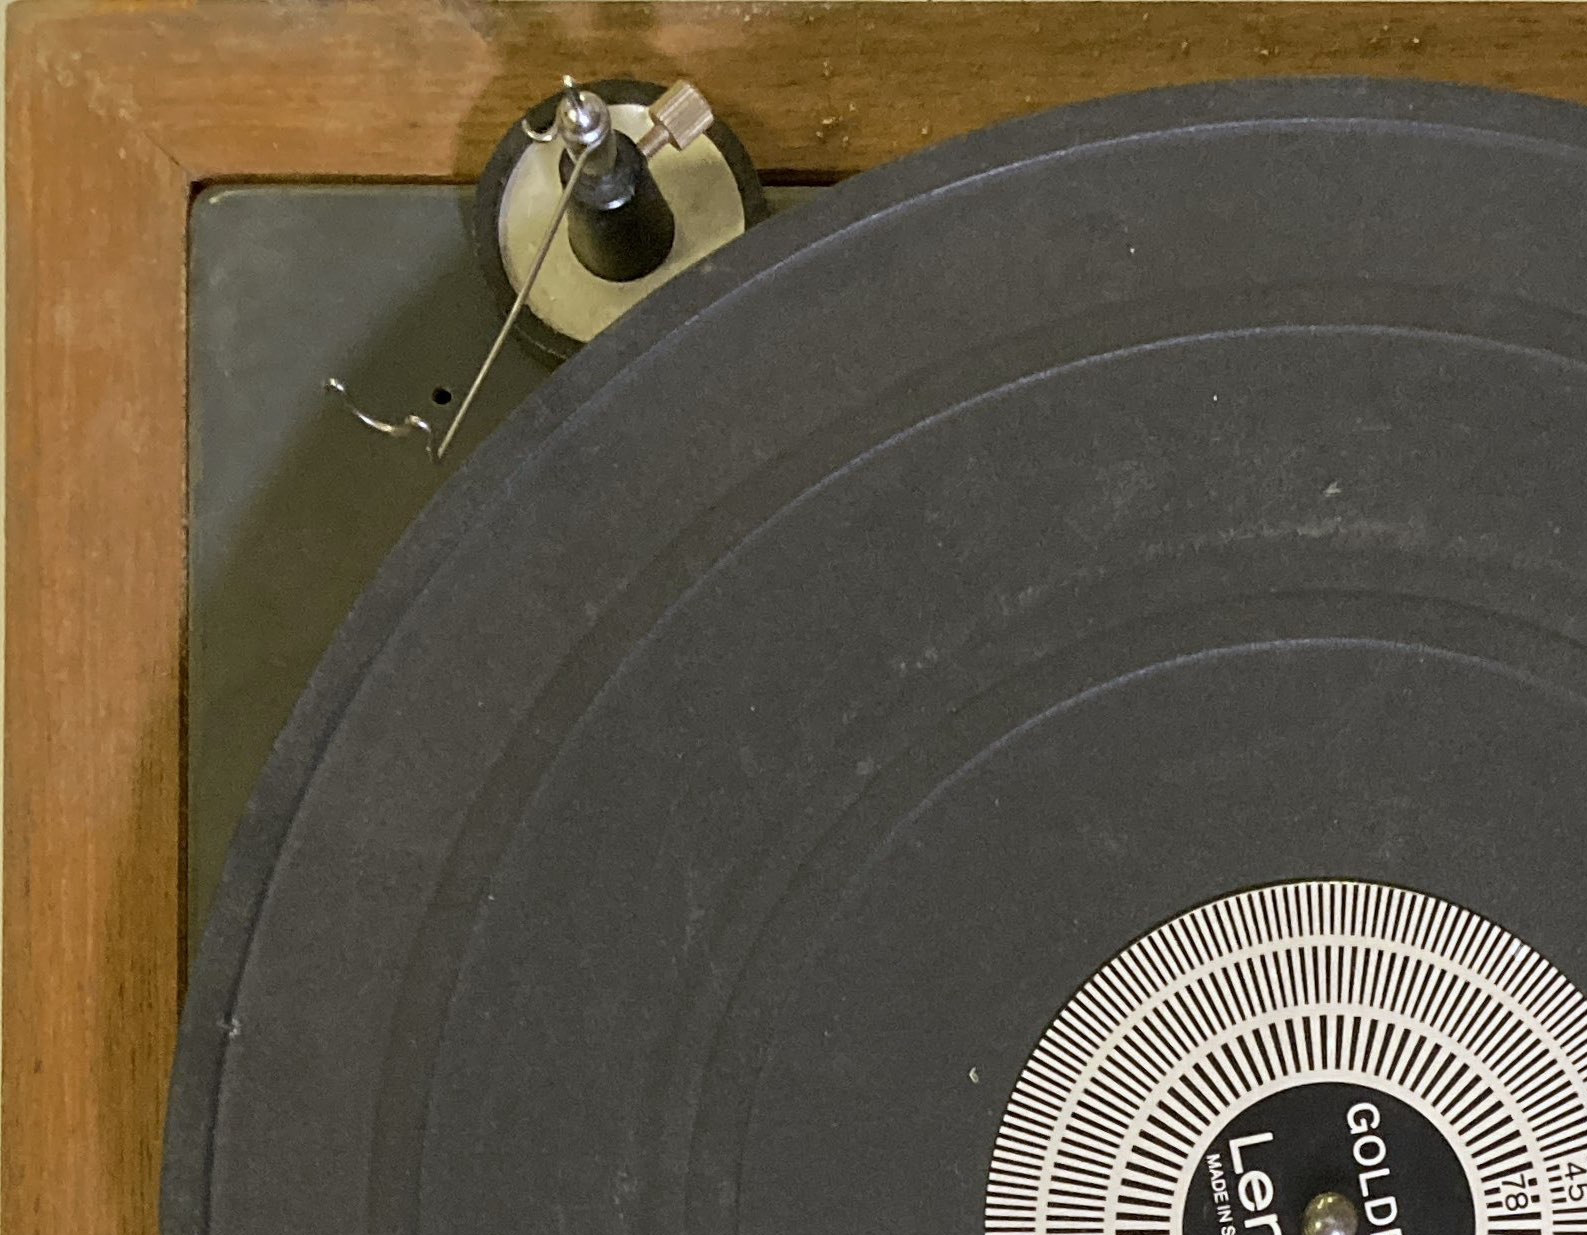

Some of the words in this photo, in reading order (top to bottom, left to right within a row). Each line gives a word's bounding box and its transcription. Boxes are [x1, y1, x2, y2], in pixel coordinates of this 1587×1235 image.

[1206, 1153, 1229, 1203] MADE
[1501, 1173, 1529, 1212] 78
[1216, 1204, 1232, 1224] IN
